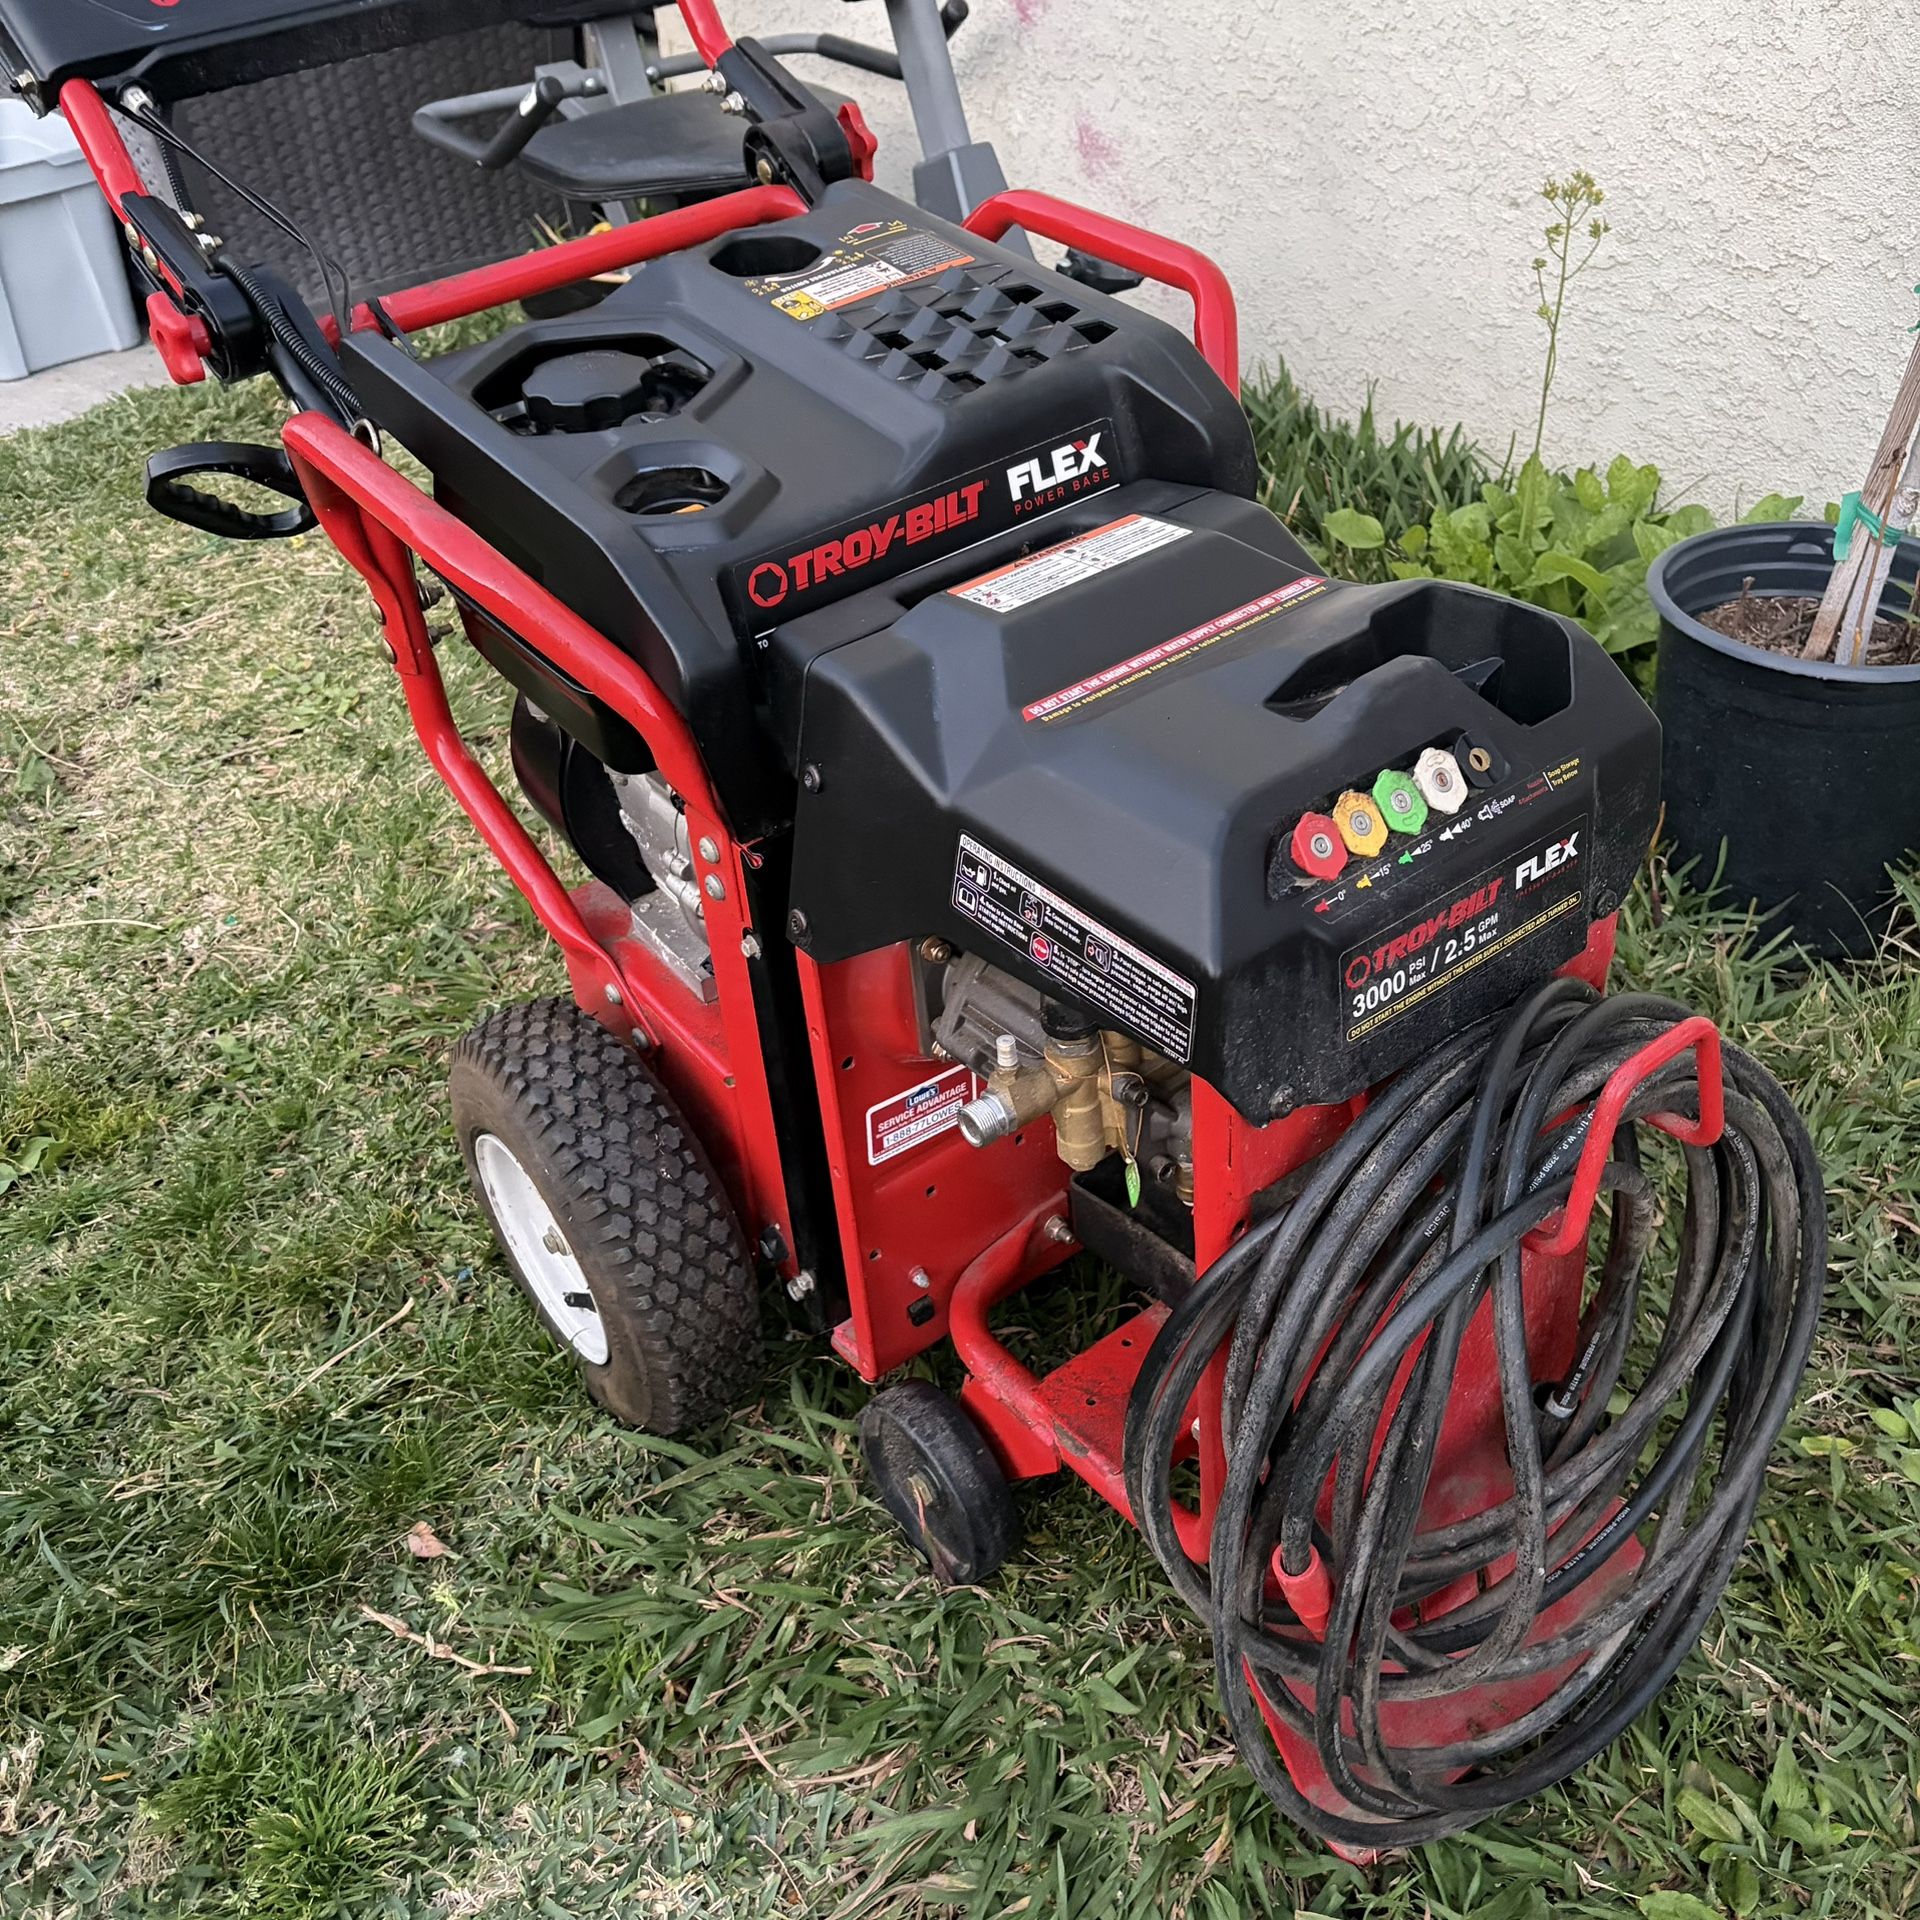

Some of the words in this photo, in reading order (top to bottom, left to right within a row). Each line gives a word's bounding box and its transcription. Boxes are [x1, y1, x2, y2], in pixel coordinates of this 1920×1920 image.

[1006, 432, 1107, 502] FLEX
[1014, 487, 1065, 516] POWER
[1072, 467, 1111, 492] BASE
[789, 479, 984, 591] TROY-BILT
[1027, 703, 1044, 715] DO
[1039, 695, 1061, 710] NOT
[1056, 684, 1086, 702] START
[1081, 676, 1103, 690] THE
[1097, 662, 1132, 683] ENGINE
[1126, 647, 1165, 669] WITHOUT
[1160, 635, 1191, 653] WATER
[1185, 623, 1218, 641] SUPPLY
[1213, 603, 1261, 628] CONNECTED
[1256, 596, 1276, 608] AND
[1271, 582, 1305, 601] TURNED
[1040, 703, 1074, 723] Damage
[1079, 682, 1120, 704] equipment
[1116, 667, 1152, 687] resulting
[1147, 659, 1169, 672] from
[1165, 648, 1192, 664] failure
[1197, 634, 1221, 648] follow
[1218, 627, 1236, 638] this
[1232, 611, 1271, 632] instruction
[1267, 605, 1284, 615] will
[1280, 598, 1299, 609] void
[1499, 794, 1516, 809] SOAP
[961, 836, 993, 864] OPERATING
[993, 856, 1037, 893] INSTRUCTIONS
[992, 869, 999, 882] 1.
[1514, 830, 1579, 891] FLEX
[1373, 874, 1504, 975] TROY-BILT
[1478, 925, 1498, 945] Max
[1351, 1025, 1360, 1038] DO
[1361, 1017, 1373, 1032] NOT
[1374, 1006, 1392, 1024] START
[1393, 998, 1405, 1012] THE
[1405, 985, 1426, 1005] ENGINE
[1427, 970, 1452, 991] WITHOUT
[1452, 963, 1462, 976] THE
[1463, 951, 1482, 969] WATER
[1483, 939, 1502, 958] SUPPLY
[1503, 920, 1535, 945] CONNECTED
[1535, 912, 1547, 926] AND
[1547, 900, 1568, 918] TURNED
[1352, 966, 1405, 1020] 3000
[1408, 955, 1426, 975] PSI
[1444, 924, 1475, 965] 2.5
[1477, 910, 1498, 934] GPM
[1408, 968, 1426, 987] Max
[877, 1107, 915, 1132] SERVICE
[916, 1082, 967, 1114] ADVANTAGE
[885, 1101, 961, 1146] 1-888-77LOWES
[1585, 1504, 1631, 1551] HIGH-PRESSURE
[1562, 1549, 1586, 1570] WATER
